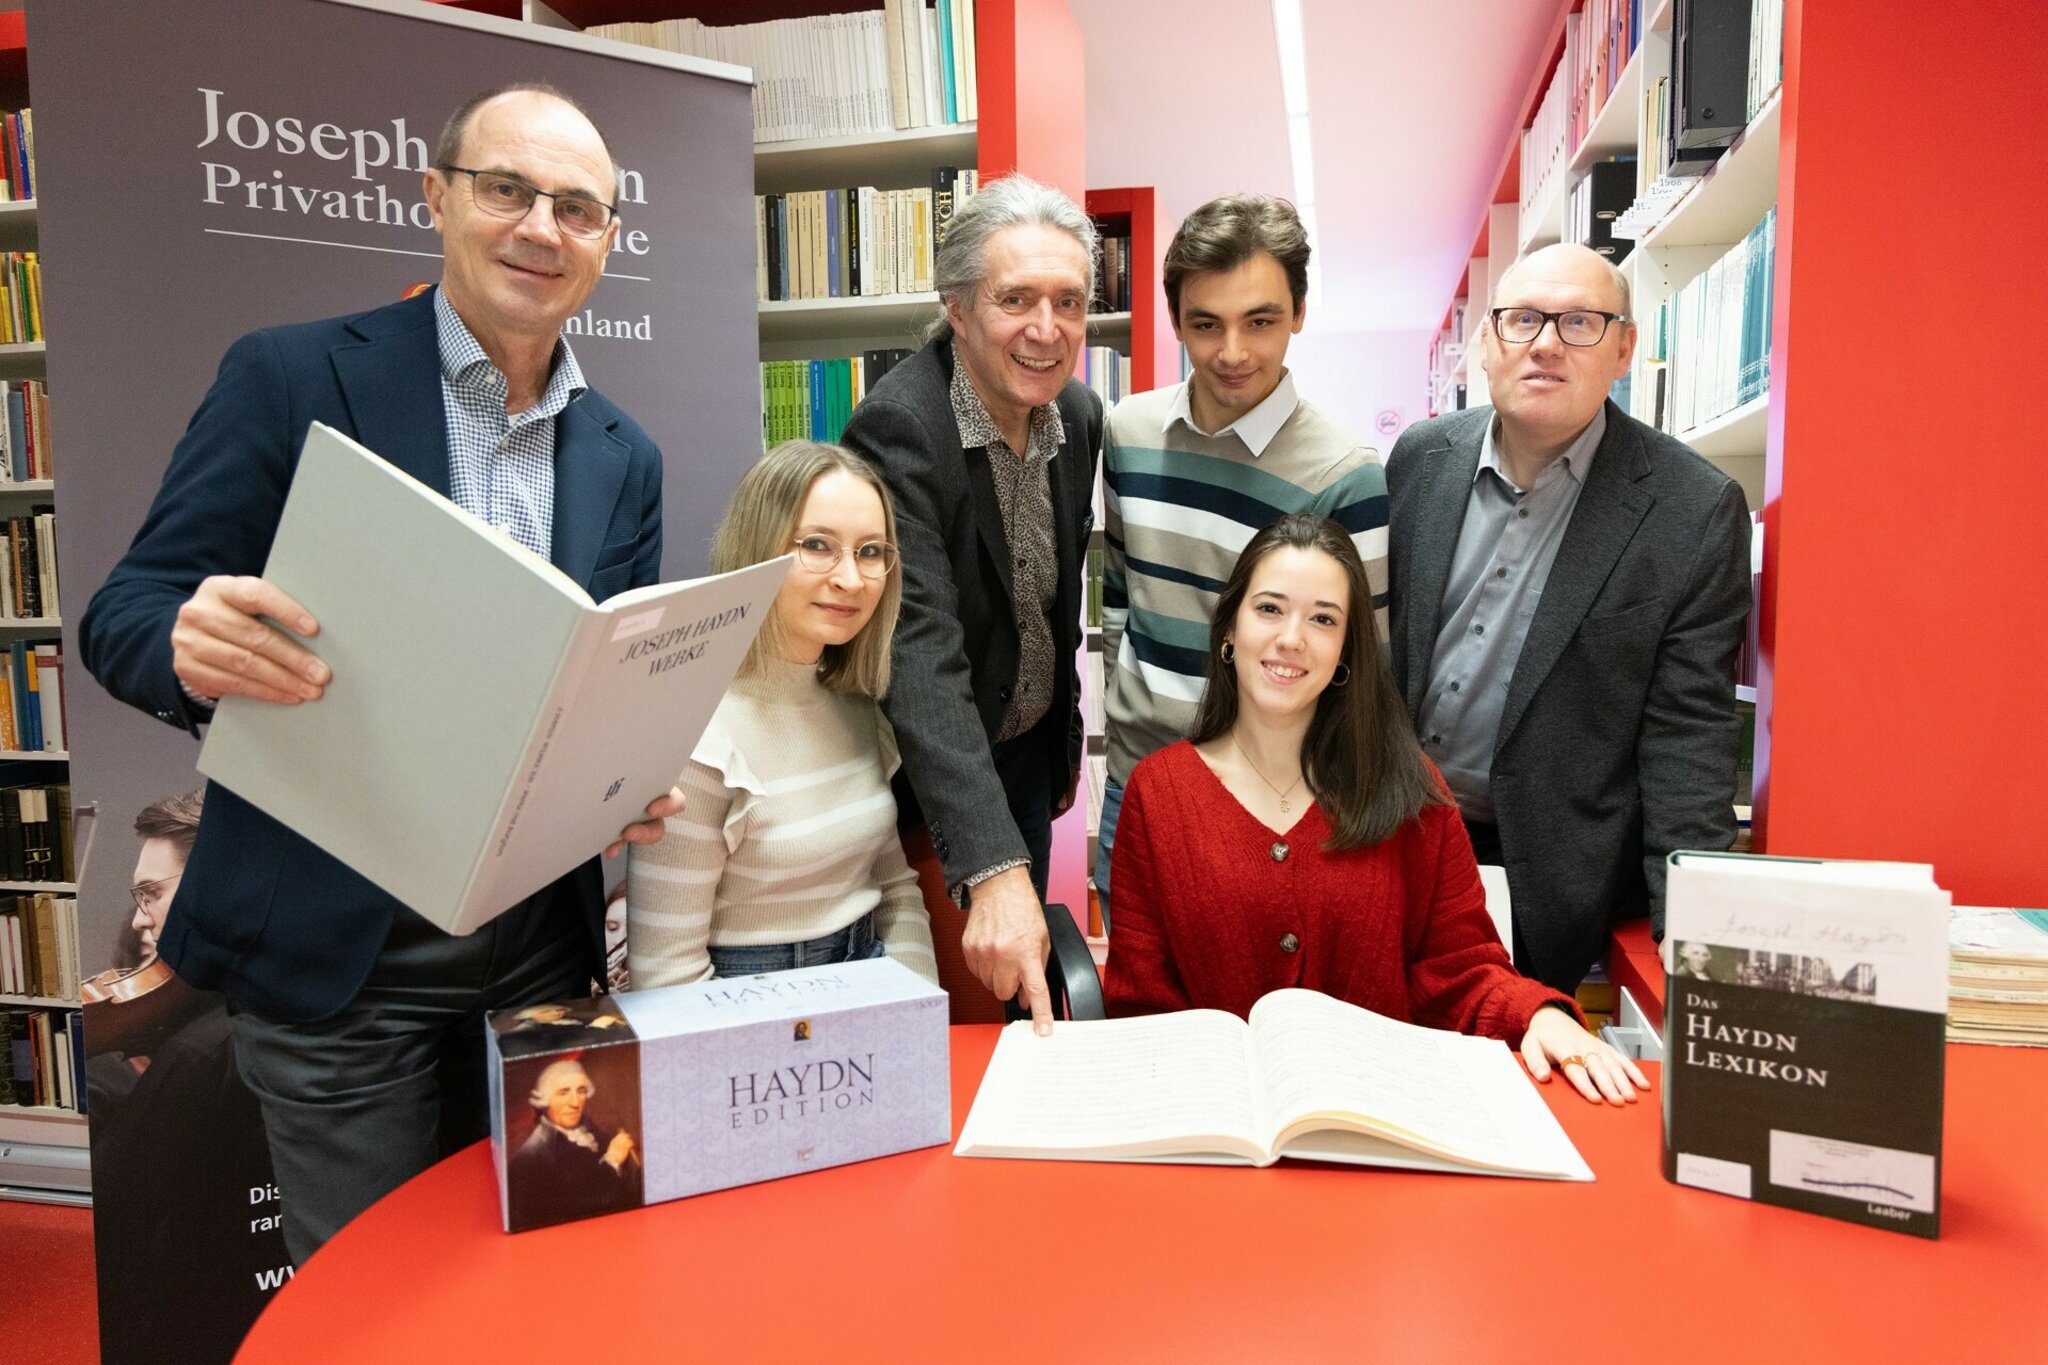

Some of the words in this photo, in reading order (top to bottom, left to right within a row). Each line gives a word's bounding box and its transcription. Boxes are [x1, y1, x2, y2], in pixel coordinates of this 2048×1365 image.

[197, 88, 429, 181] Joseph
[565, 308, 653, 341] nland
[619, 624, 693, 664] JOSEPH
[692, 602, 751, 638] HAYDN
[648, 640, 709, 677] WERKE
[705, 975, 843, 1003] HAYDN
[728, 1053, 875, 1109] HAYDN
[731, 1089, 873, 1130] EDITION
[249, 1183, 281, 1205] Dis
